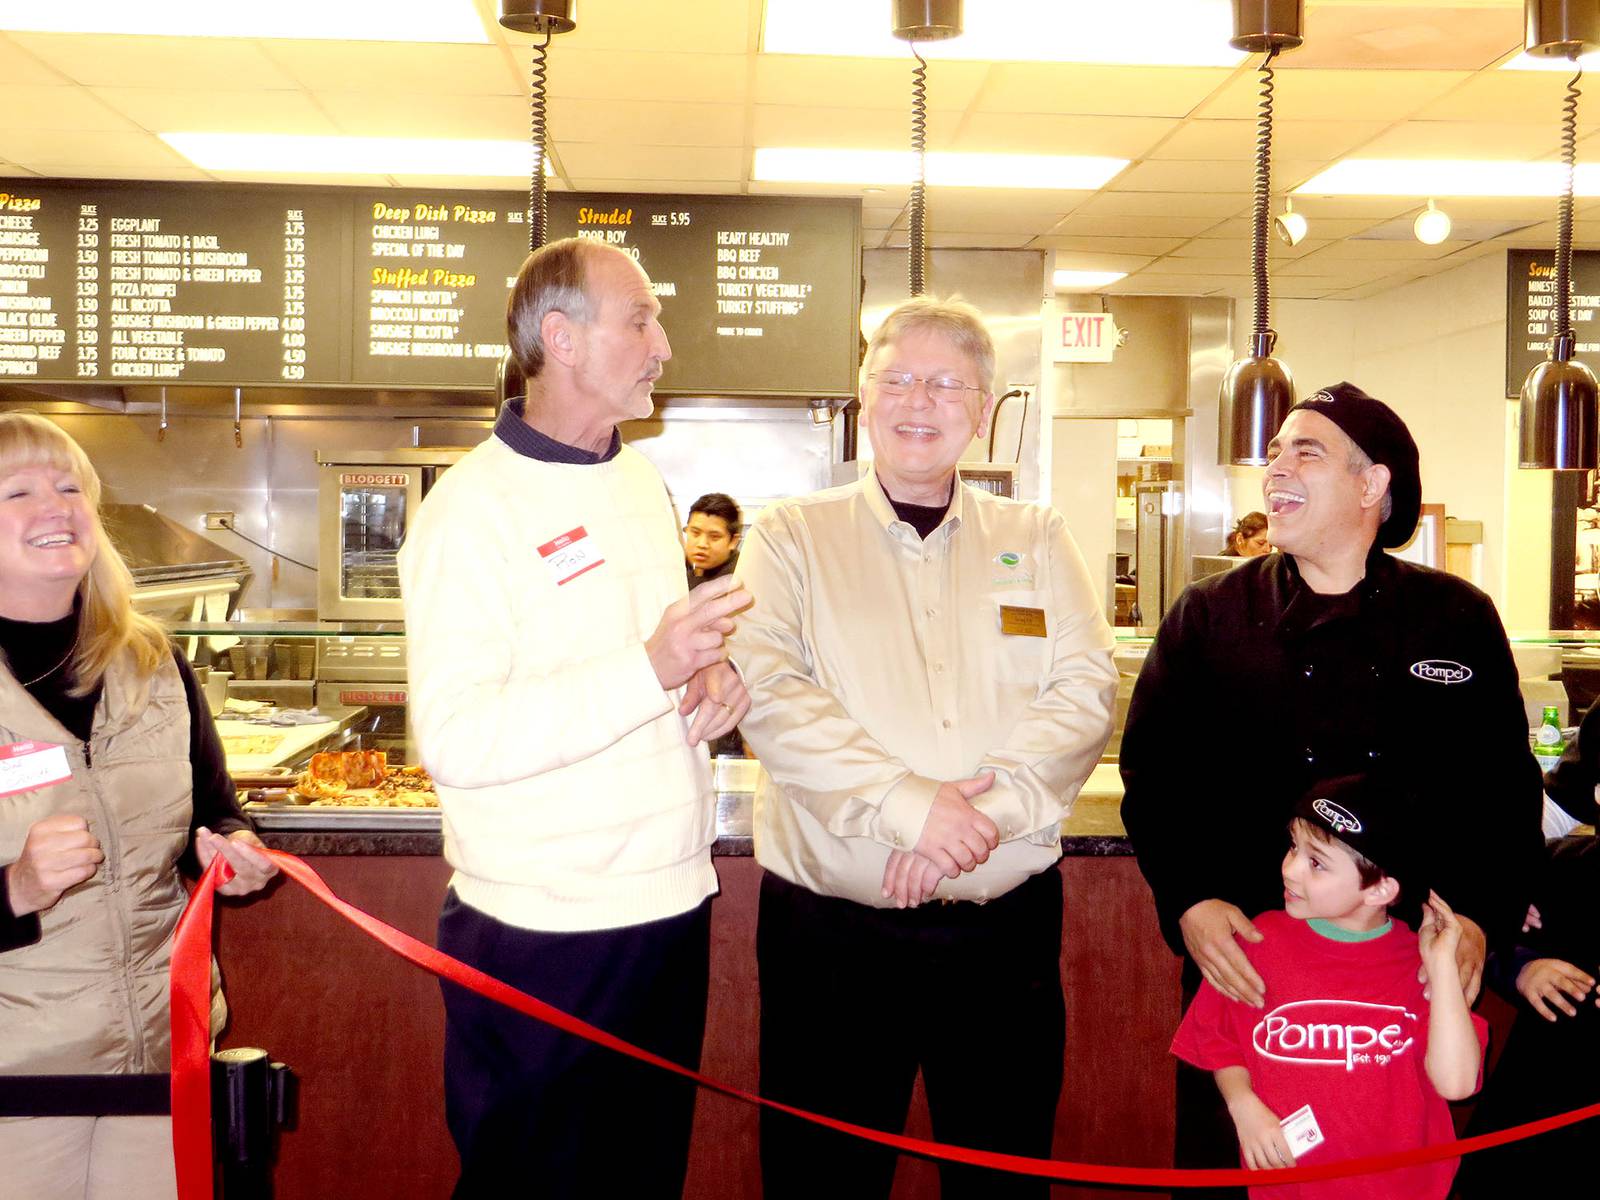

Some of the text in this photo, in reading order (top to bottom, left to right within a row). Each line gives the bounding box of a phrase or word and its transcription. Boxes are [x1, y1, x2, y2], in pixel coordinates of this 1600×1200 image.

[81, 205, 97, 215] SLICE
[287, 210, 304, 220] SLICE
[373, 202, 411, 224] Deep
[414, 204, 449, 222] Dish
[453, 205, 497, 224] Pizza
[507, 212, 524, 223] SLICE
[578, 208, 691, 226] Strudel SLICE 5.95
[78, 218, 98, 232] 3.25
[111, 218, 305, 236] EGGPLANT 3.75
[372, 225, 414, 239] CHICKEN
[77, 234, 98, 248] 3.50
[111, 234, 305, 252] FRESH TOMATO & BASIL 3.75
[606, 230, 627, 244] BOY
[717, 232, 790, 247] HEART HEALTHY
[77, 250, 98, 264] 3.50
[372, 242, 465, 258] SPECIAL OF THE DAY
[717, 249, 761, 263] BBQ BEEF
[111, 251, 305, 268] FRESH TOMATO & MUSHROOM 3.75
[76, 266, 98, 280] 3.50
[111, 267, 305, 284] FRESH TOMATO & GREEN PEPPER 3.75
[372, 267, 476, 289] Stuffed Pizza
[717, 266, 779, 281] BBQ CHICKEN
[76, 282, 98, 296] 3.50
[111, 283, 305, 300] PIZZA POMPEI 3.75
[717, 283, 753, 297] TURKEY
[371, 289, 411, 304] SPINACH
[1528, 295, 1553, 307] BAKED
[76, 298, 98, 312] 3.50
[111, 299, 305, 316] ALL RICOTTA 3.75
[717, 300, 754, 314] TURKEY
[30, 313, 58, 327] OLIVE
[76, 314, 98, 328] 3.50
[370, 307, 418, 321] BROCCOLI
[1528, 309, 1549, 321] SOUP
[1577, 309, 1593, 321] DAY
[111, 315, 152, 329] SAUSAGE
[152, 316, 204, 329] MUSHROOM
[206, 316, 215, 330] &
[215, 316, 245, 330] GREEN
[245, 317, 279, 331] PEPPER
[1527, 323, 1547, 335] CHILI
[29, 330, 65, 343] PEPPER
[76, 330, 98, 344] 3.50
[111, 331, 130, 345] ALL
[131, 331, 184, 345] VEGETABLE
[370, 324, 412, 338] SAUSAGE
[1061, 316, 1105, 348] EXIT
[38, 346, 62, 360] BEEF
[77, 347, 98, 361] 3.75
[111, 348, 138, 361] FOUR
[138, 348, 175, 361] CHEESE
[176, 348, 185, 362] &
[187, 348, 226, 362] TOMATO
[369, 341, 410, 355] SAUSAGE
[411, 342, 464, 357] MUSHROOM
[464, 343, 473, 358] &
[77, 363, 98, 377] 3.75
[111, 363, 153, 377] CHICKEN
[281, 365, 305, 379] 4.50
[344, 474, 405, 485] BLODGETT
[1418, 662, 1464, 686] Pompei
[1315, 799, 1357, 829] Pompei
[1265, 1016, 1402, 1072] Pompe
